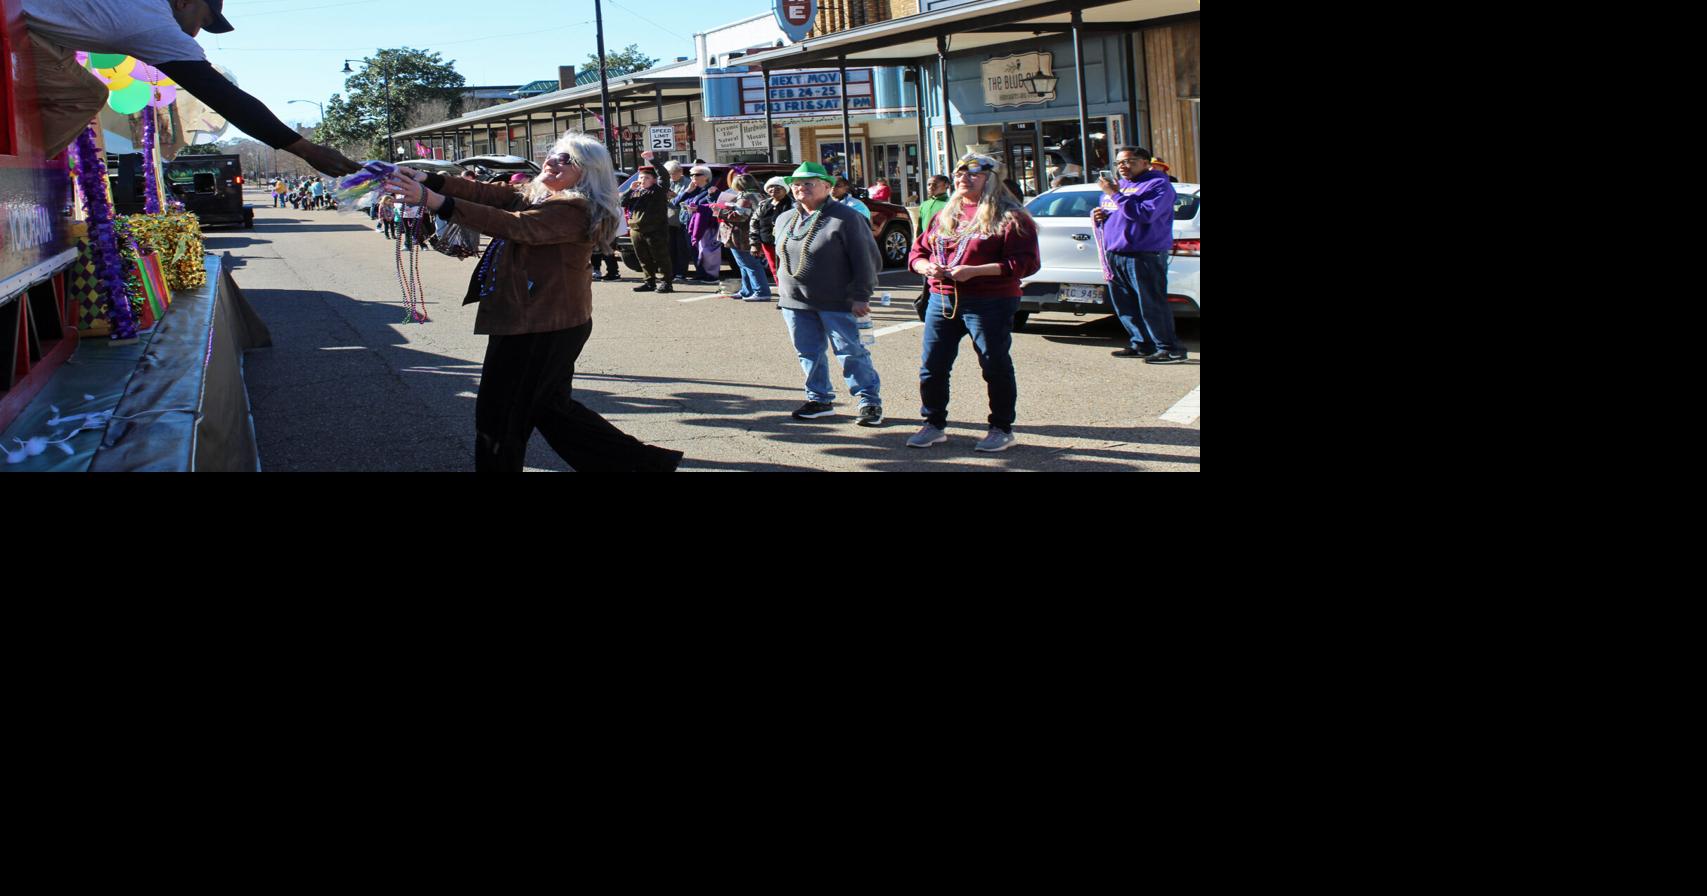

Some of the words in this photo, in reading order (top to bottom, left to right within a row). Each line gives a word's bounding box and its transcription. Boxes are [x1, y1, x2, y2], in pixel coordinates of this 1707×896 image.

[771, 75, 801, 86] NEXT
[807, 72, 850, 84] MOVE
[988, 77, 1002, 91] THE
[771, 88, 794, 98] FEB
[853, 97, 871, 107] PM
[653, 139, 672, 149] 25
